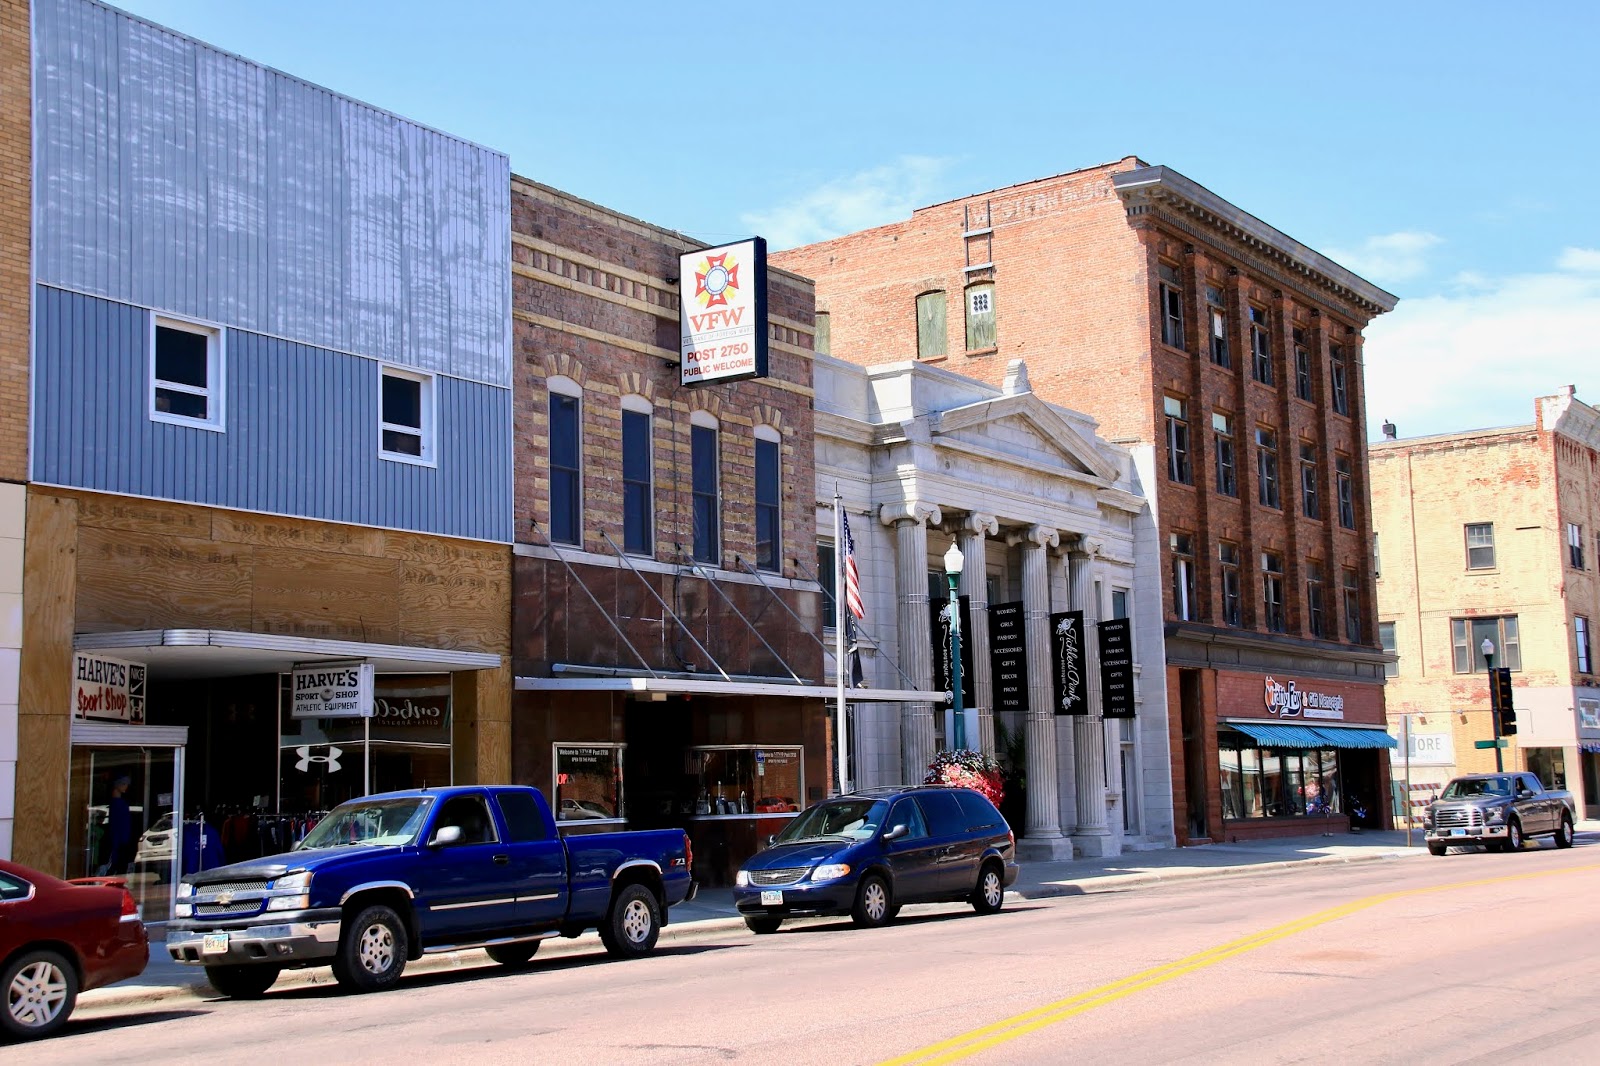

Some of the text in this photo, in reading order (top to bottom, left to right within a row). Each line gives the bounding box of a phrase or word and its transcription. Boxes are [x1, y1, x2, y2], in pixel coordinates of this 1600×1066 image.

[690, 306, 745, 332] VFW
[687, 342, 749, 363] POST 2750
[683, 358, 753, 377] PUBLIC WELCOME
[996, 607, 1016, 615] WOMENS
[77, 656, 126, 688] HARVE'S
[130, 667, 144, 680] NIKE
[296, 669, 358, 691] HARVE'S
[77, 686, 127, 719] Sport Shop
[295, 690, 359, 701] SPORT SHOP
[296, 701, 358, 712] ATHLETIC EQUIPMENT
[1414, 737, 1441, 751] ORE
